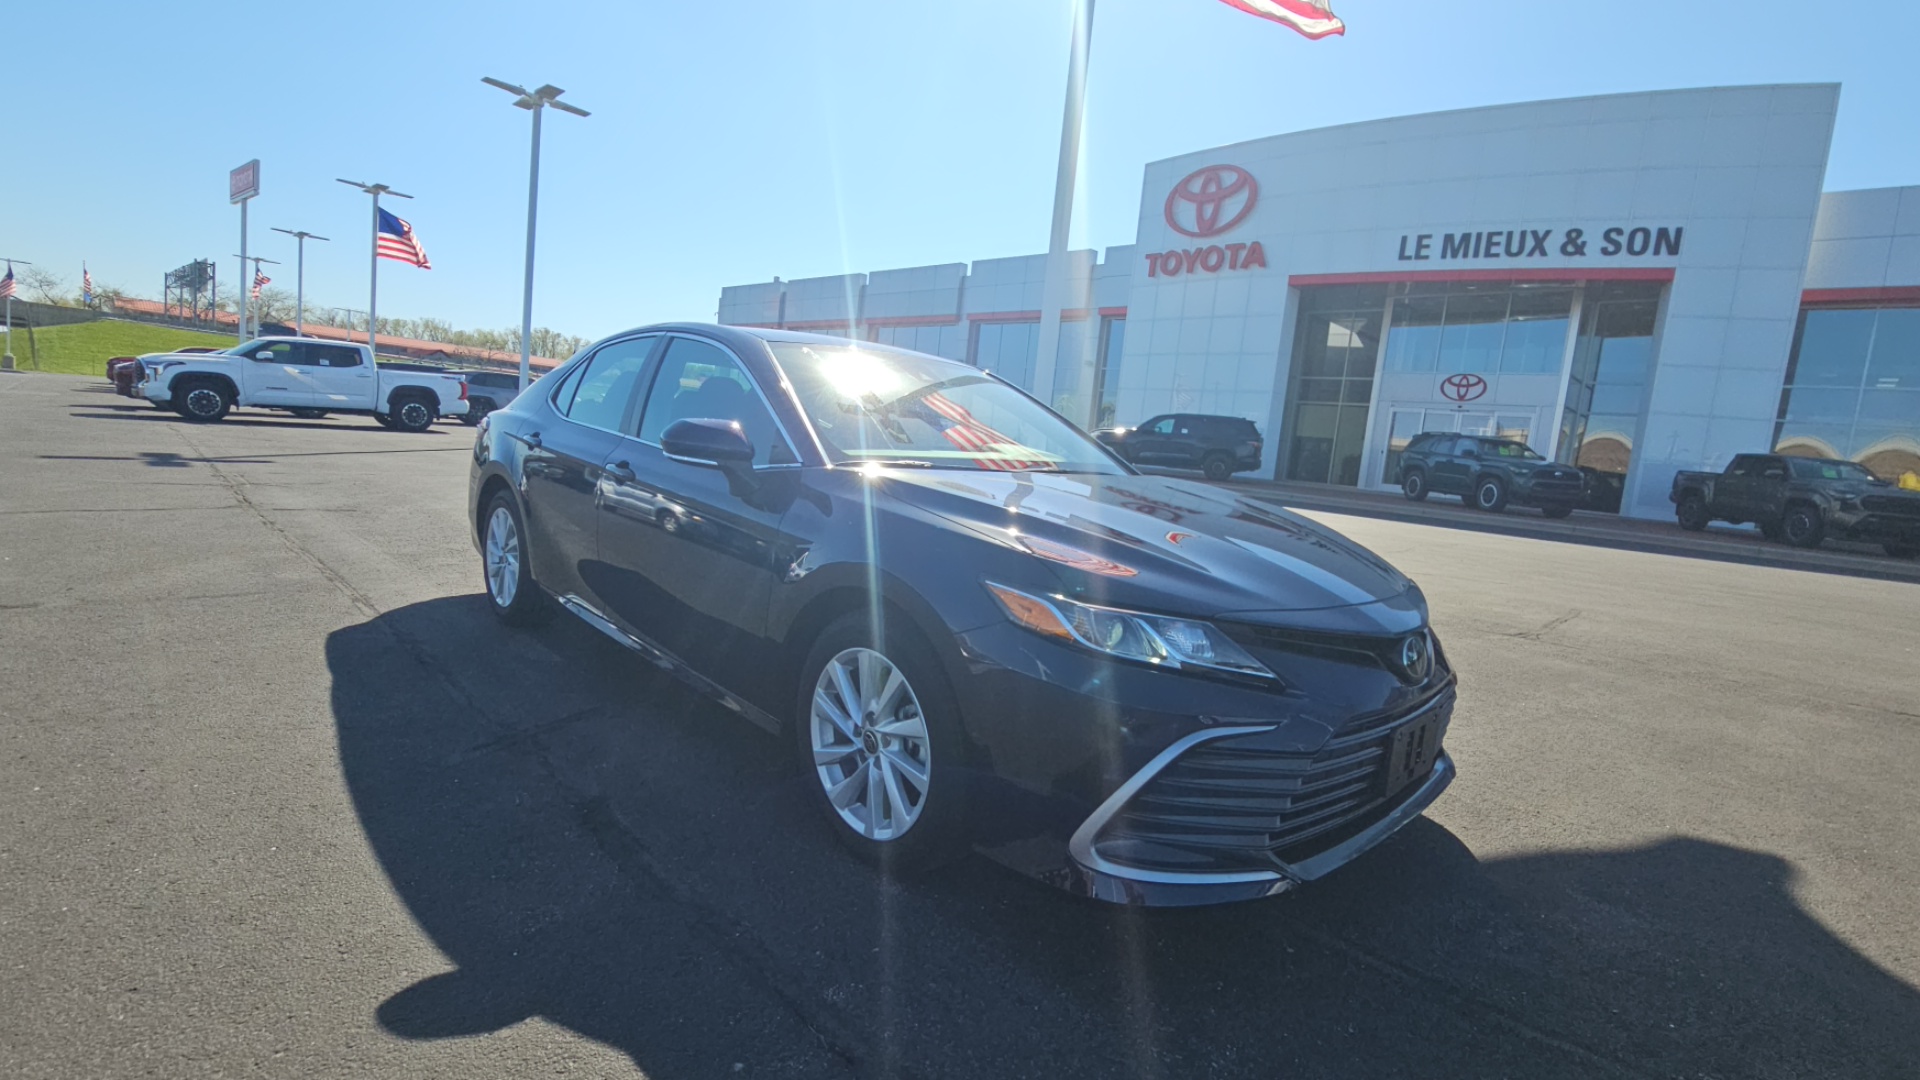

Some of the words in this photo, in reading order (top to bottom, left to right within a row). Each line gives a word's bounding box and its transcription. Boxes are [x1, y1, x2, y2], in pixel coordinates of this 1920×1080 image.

[1145, 241, 1267, 278] TOYOTA
[1398, 233, 1433, 261] LE
[1440, 229, 1553, 260] MIEUX
[1560, 227, 1588, 257] &
[1600, 226, 1684, 257] SON
